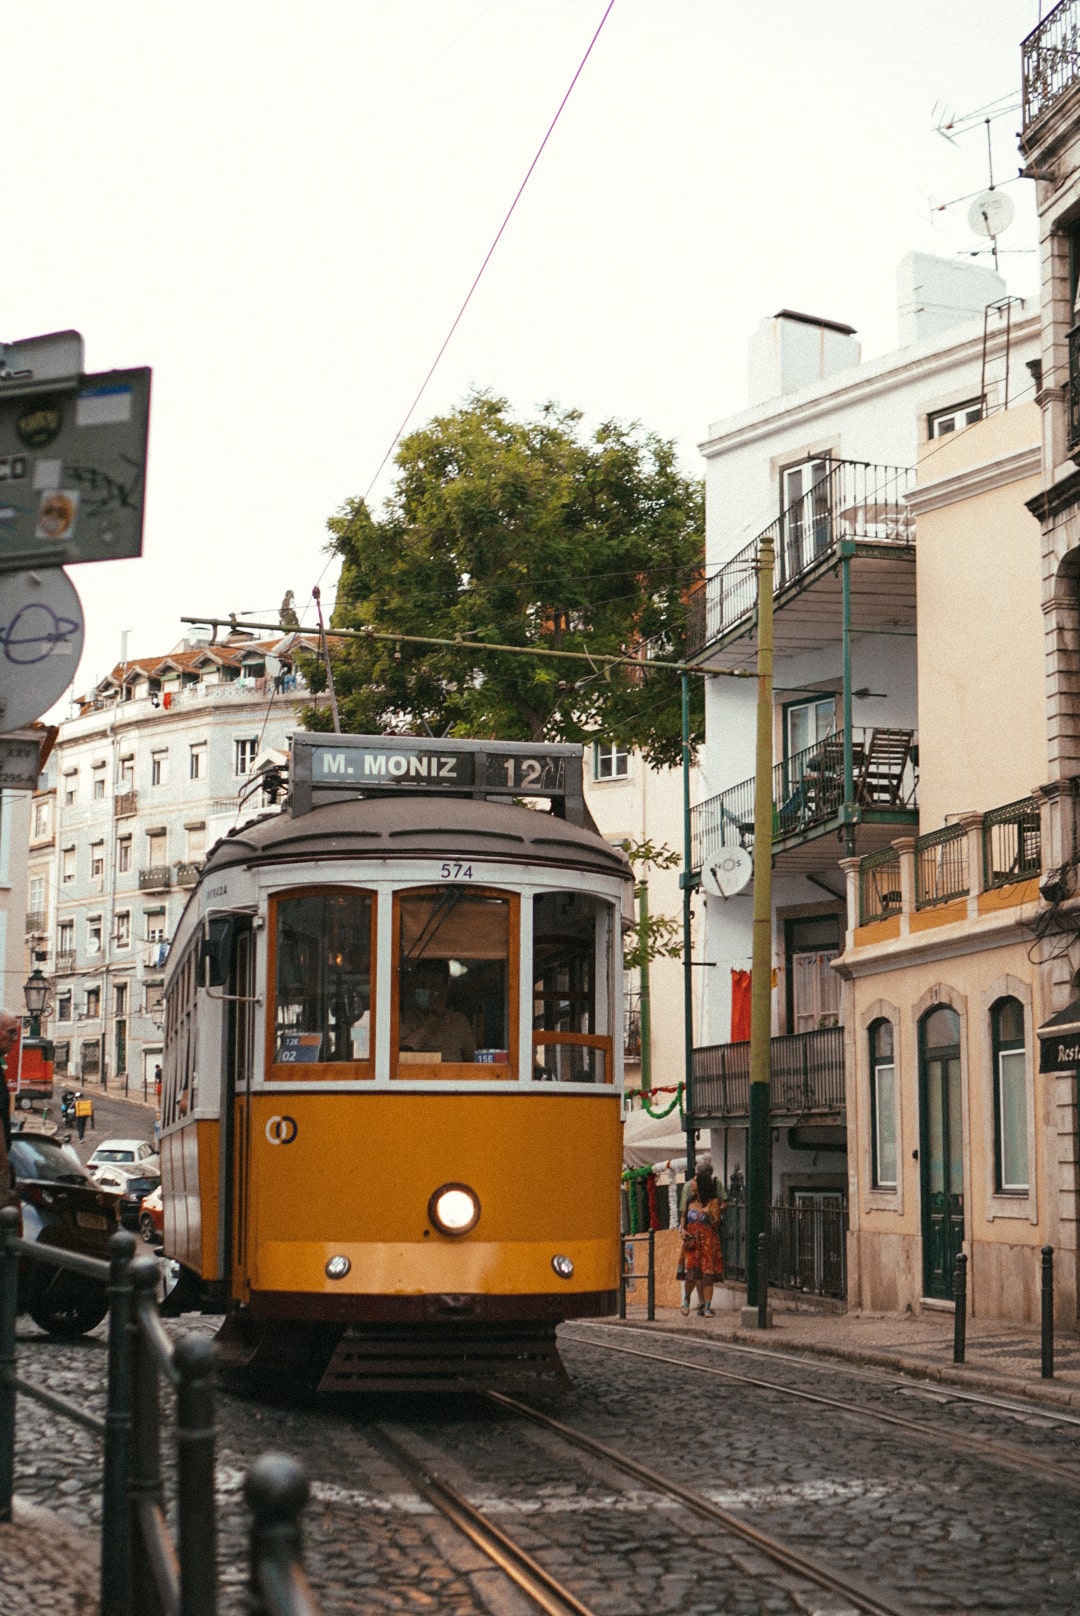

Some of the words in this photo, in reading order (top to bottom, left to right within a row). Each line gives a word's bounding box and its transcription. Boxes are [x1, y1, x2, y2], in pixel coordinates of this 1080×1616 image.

[323, 753, 354, 775] M.
[364, 755, 457, 778] MONIZ
[503, 758, 542, 789] 12
[441, 863, 473, 879] 574
[286, 1038, 299, 1046] 12E
[282, 1051, 297, 1061] 02
[478, 1054, 493, 1063] 15E
